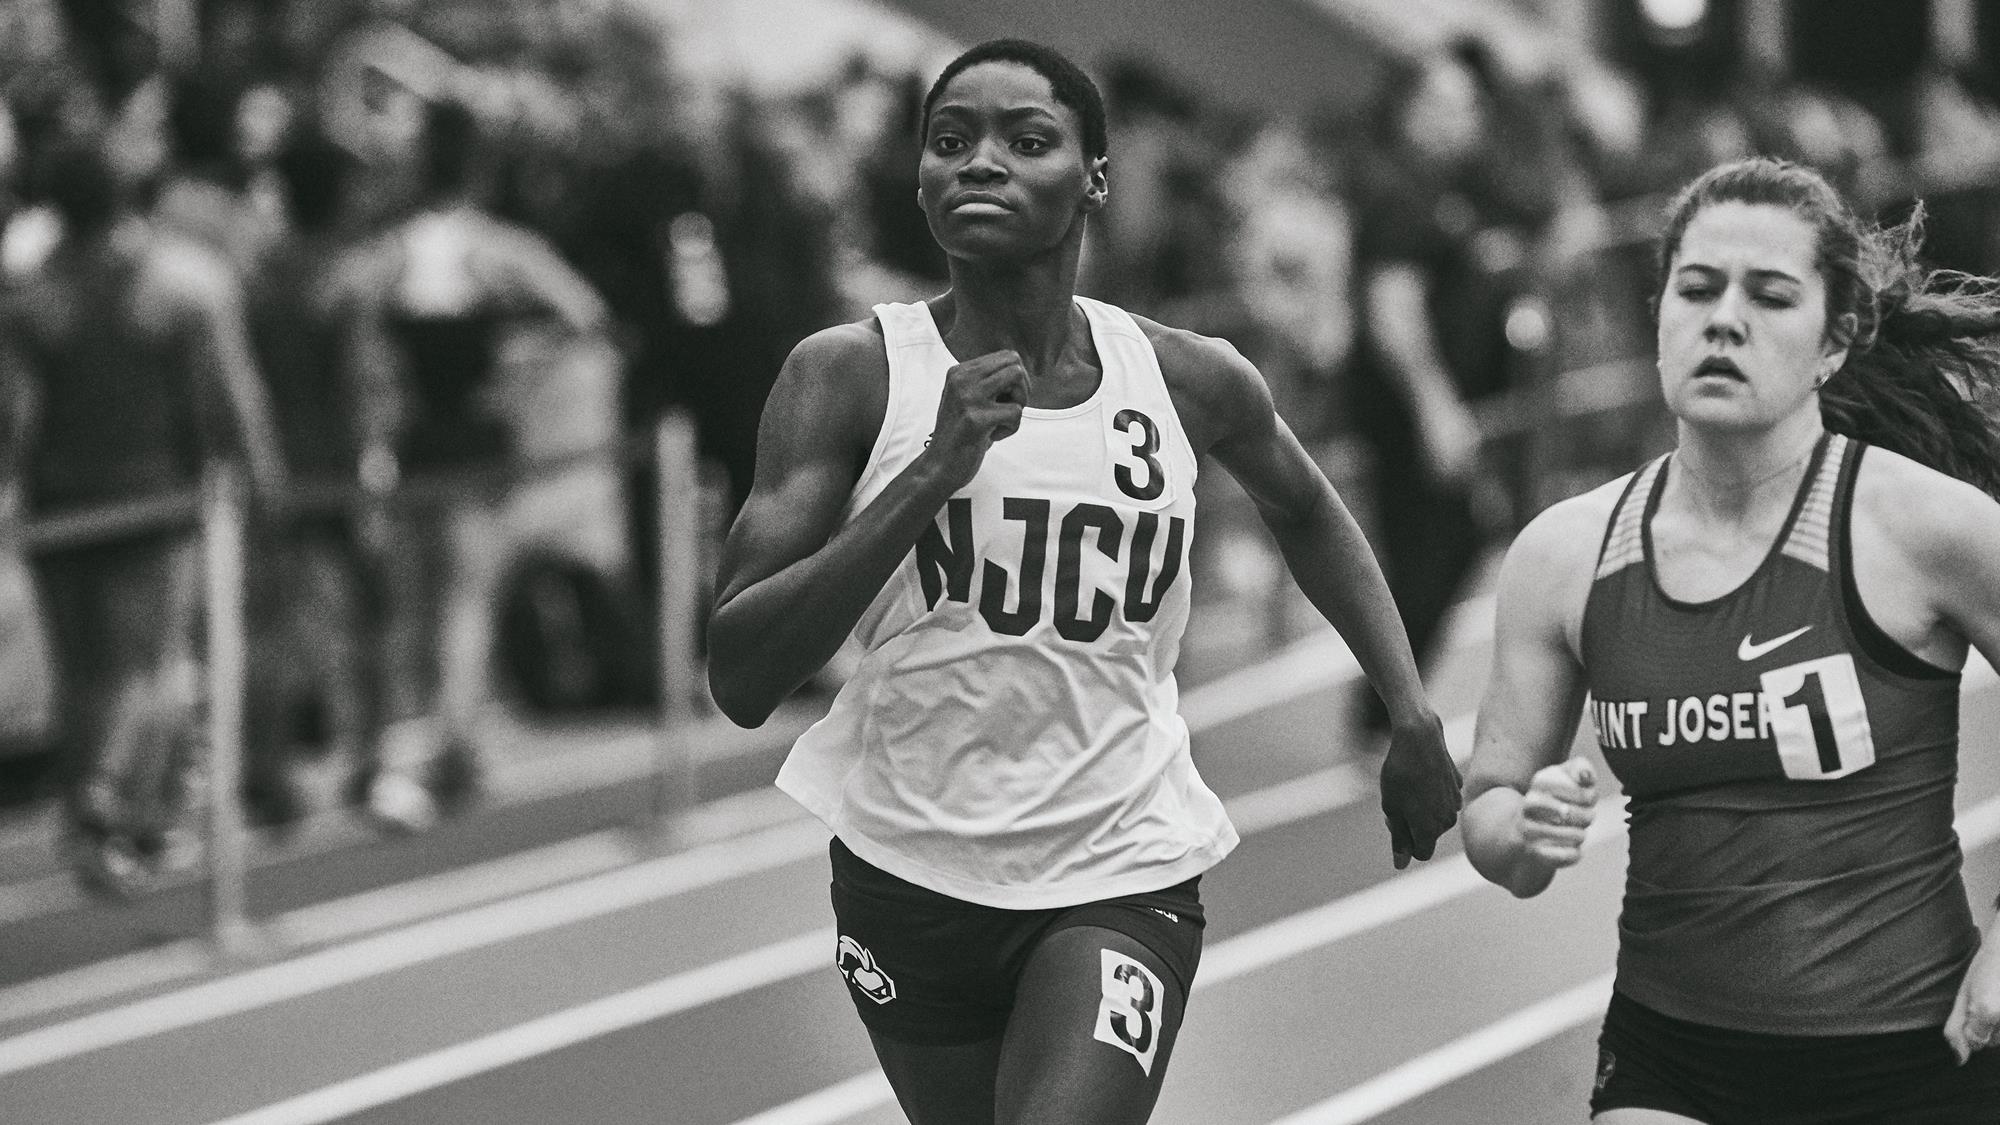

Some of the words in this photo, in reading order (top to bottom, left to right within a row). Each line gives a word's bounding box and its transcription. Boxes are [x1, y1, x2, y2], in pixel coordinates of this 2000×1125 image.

[1112, 408, 1166, 501] 3
[915, 497, 1186, 643] NJCU
[1782, 671, 1843, 774] 1
[1109, 963, 1155, 1053] 3
